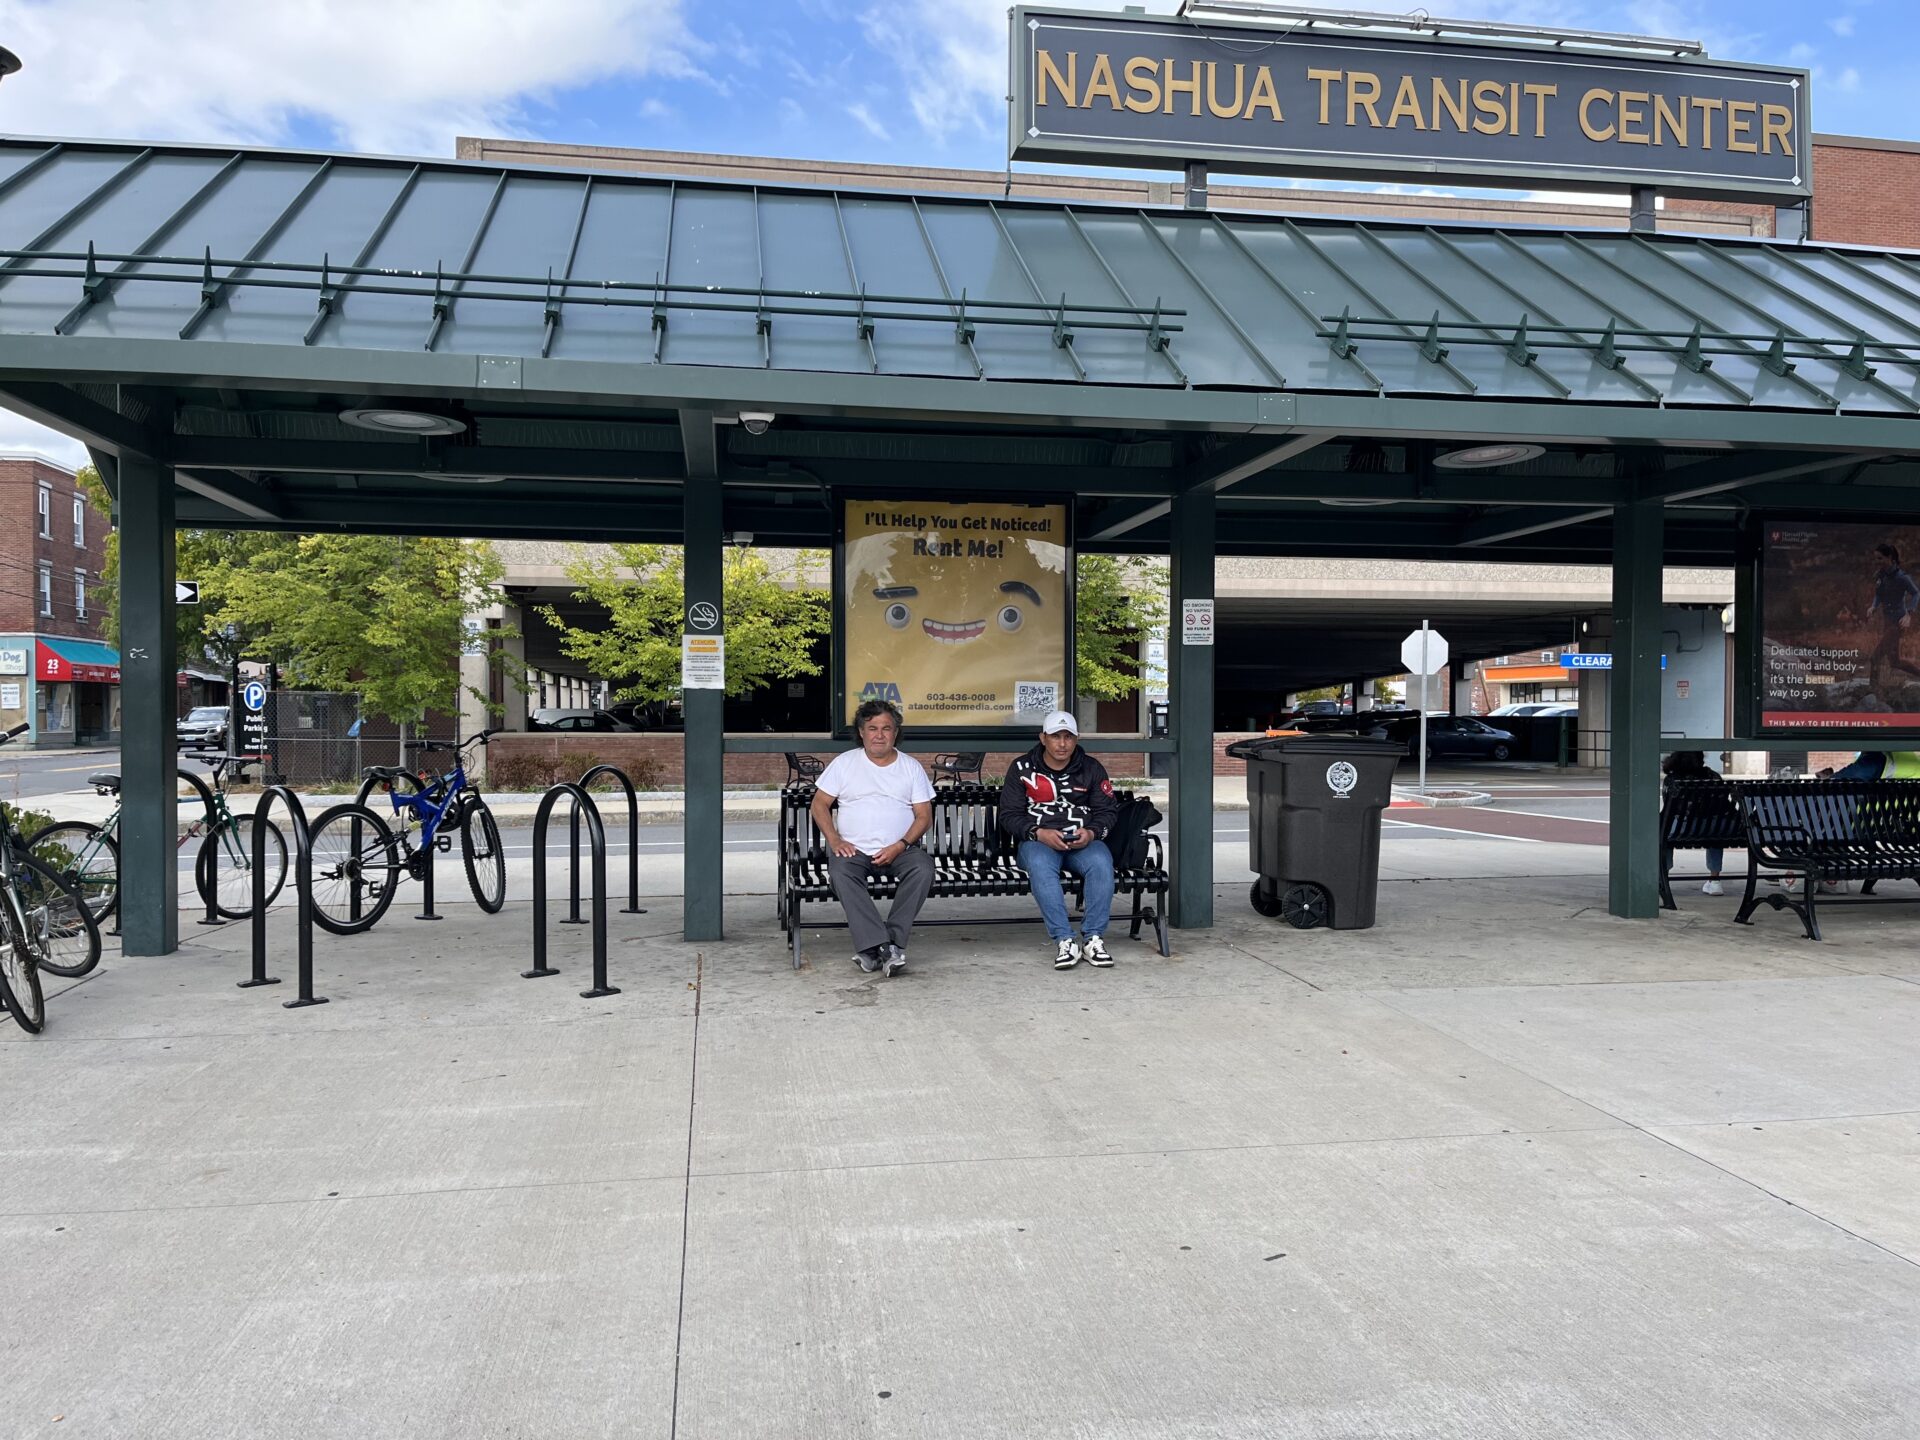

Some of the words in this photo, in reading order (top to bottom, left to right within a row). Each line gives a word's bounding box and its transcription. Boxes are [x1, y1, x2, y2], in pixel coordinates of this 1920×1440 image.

[1036, 49, 1285, 122] NASHUA
[1307, 66, 1557, 138] TRANSIT
[1578, 88, 1795, 157] CENTER
[891, 514, 927, 531] Help
[931, 515, 957, 529] You
[961, 517, 987, 530] Get
[991, 518, 1052, 532] Noticed!
[913, 538, 962, 557] Rent
[967, 539, 1004, 559] Me!
[3, 651, 21, 662] Dog
[1771, 645, 1818, 657] Dedicated
[1820, 649, 1859, 659] support
[47, 659, 59, 670] 23
[1770, 660, 1785, 670] for
[1788, 660, 1812, 670] mind
[1814, 661, 1831, 671] and
[1833, 661, 1857, 673] body
[1770, 674, 1784, 684] it's
[1787, 674, 1803, 684] the
[1805, 675, 1835, 684] better
[926, 693, 996, 702] 603-436-0008
[1769, 689, 1787, 699] way
[1790, 689, 1800, 697] to
[1802, 690, 1817, 699] go.
[908, 702, 1013, 712] ataoutdoormedia.com
